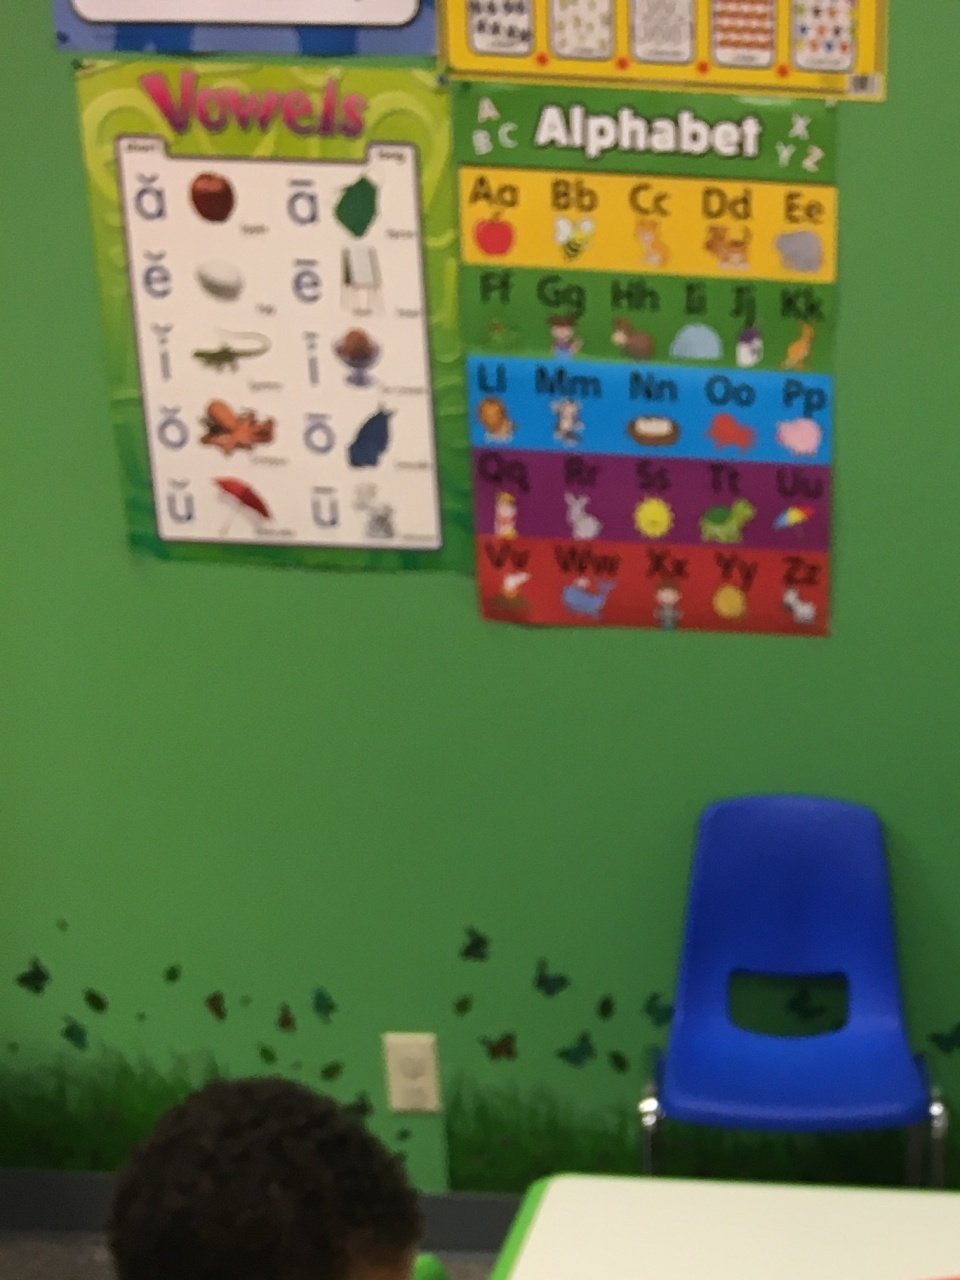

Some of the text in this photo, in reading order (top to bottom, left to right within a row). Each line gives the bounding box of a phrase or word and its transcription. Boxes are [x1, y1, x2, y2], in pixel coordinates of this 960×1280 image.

[138, 69, 369, 138] Vowels
[534, 103, 763, 160] Alphabet
[469, 176, 824, 224] Aa Bb Cc Dd Ee
[537, 274, 586, 318] Gg
[535, 366, 601, 396] Mm
[630, 371, 678, 402] Nn
[706, 375, 756, 406] Oo
[783, 379, 826, 417] Pp
[479, 452, 530, 493] Qq
[635, 460, 671, 491] Ss
[708, 464, 741, 494] Tt
[776, 468, 824, 499] Uu
[715, 552, 758, 591] Yy
[783, 556, 821, 586] Zz
